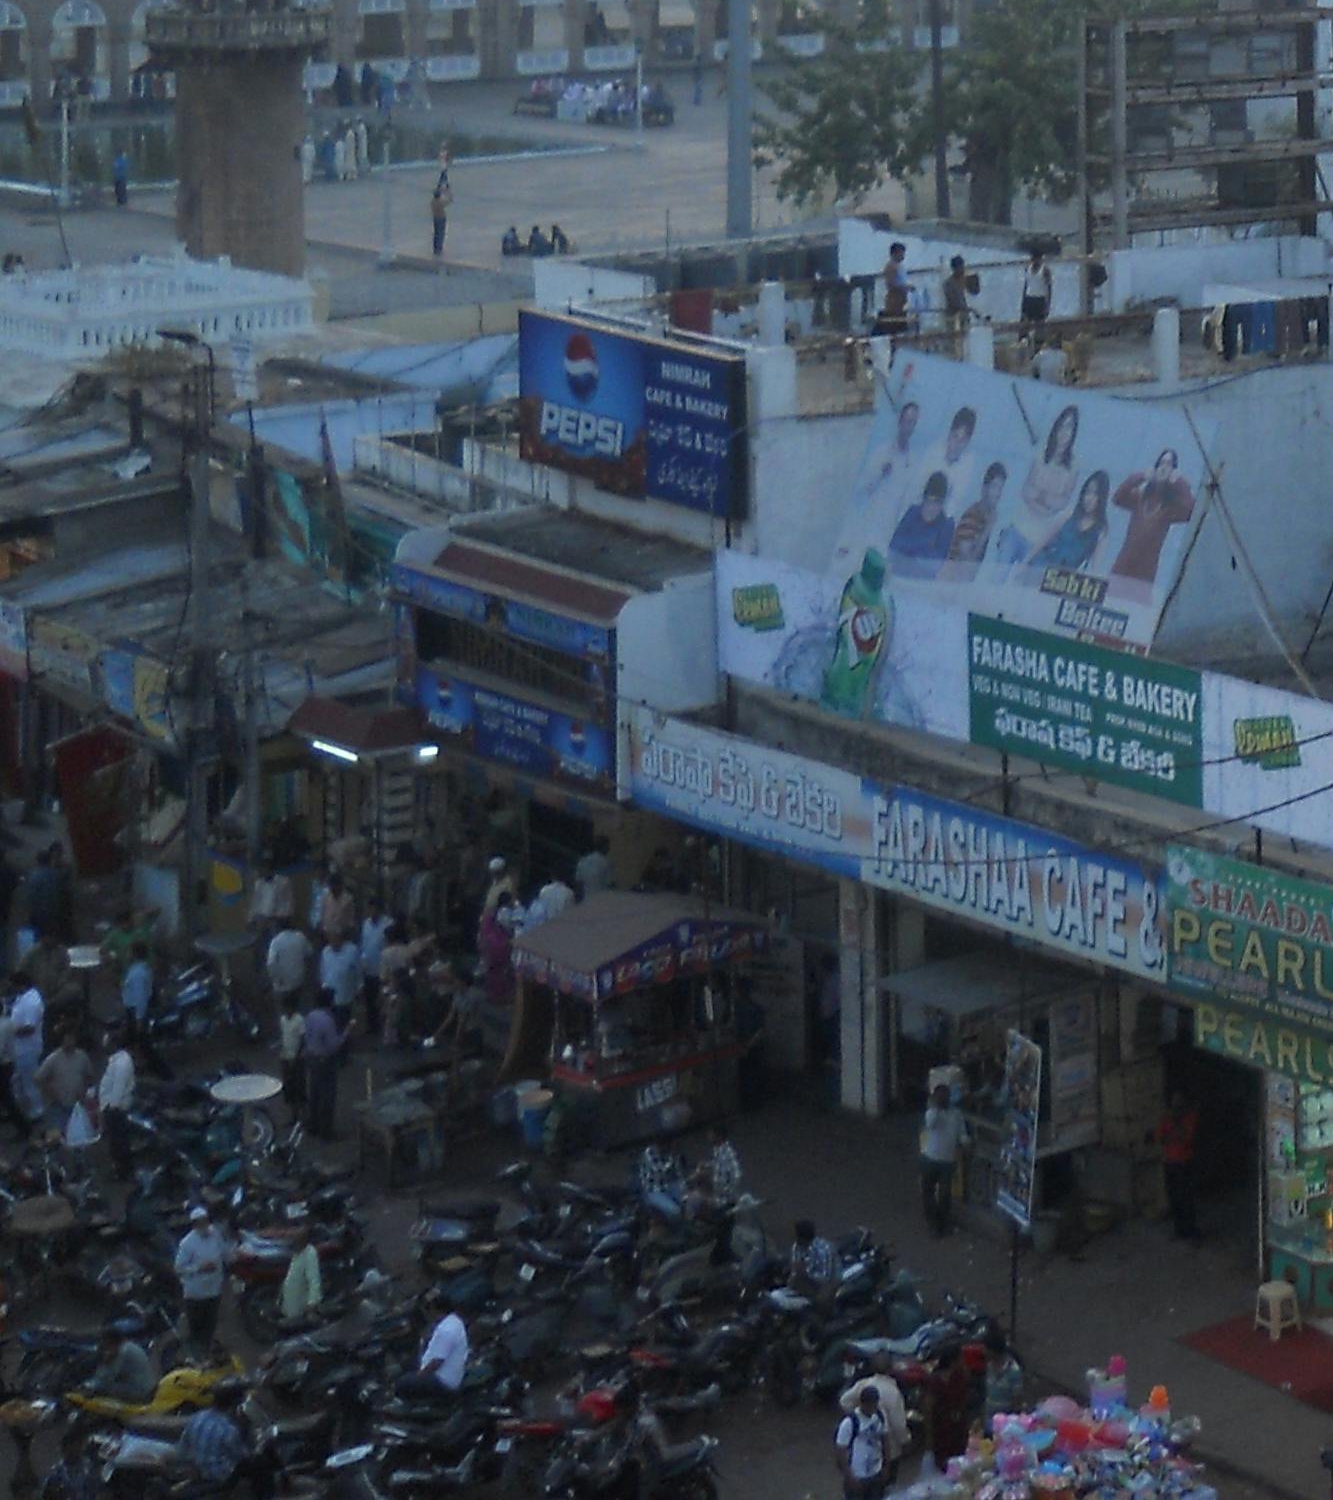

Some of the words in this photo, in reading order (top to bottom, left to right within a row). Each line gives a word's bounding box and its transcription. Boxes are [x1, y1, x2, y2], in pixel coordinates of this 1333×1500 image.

[661, 361, 711, 389] NIMRAH
[541, 402, 623, 456] PEPSI
[646, 386, 672, 407] CAFE
[675, 394, 682, 408] &
[685, 396, 728, 421] BAKERY
[973, 635, 1048, 683] FARASHA
[1053, 656, 1098, 697] CAFE
[1104, 671, 1117, 701] &
[1123, 676, 1197, 722] BAKERY
[872, 796, 1032, 926] FARASHAA
[1042, 848, 1127, 957] CAFE
[1140, 882, 1164, 967] &
